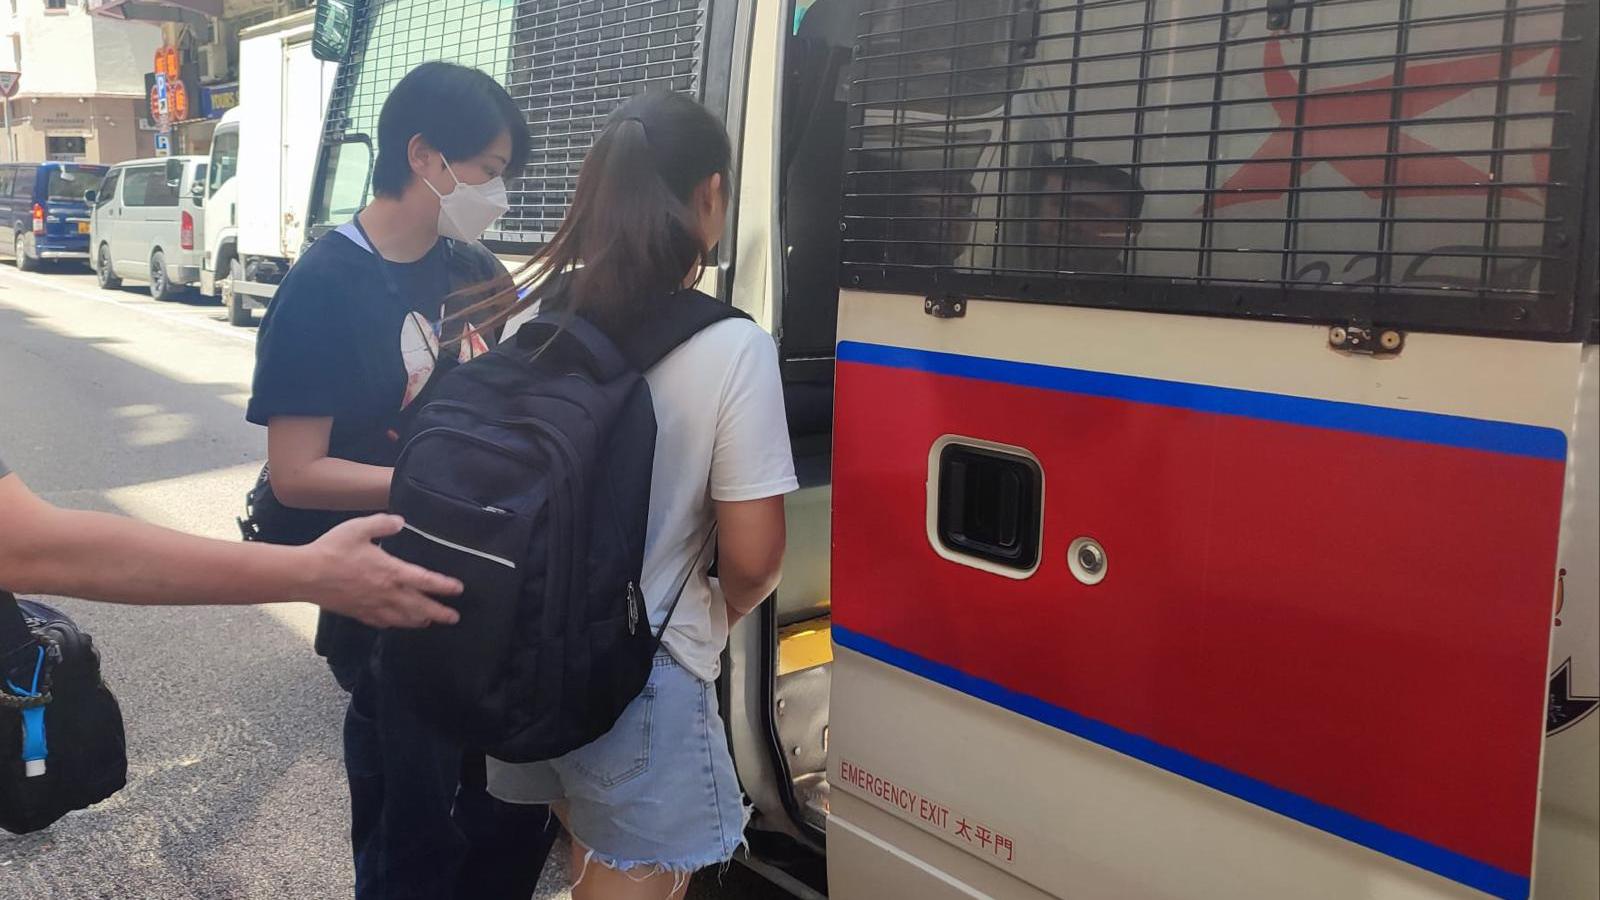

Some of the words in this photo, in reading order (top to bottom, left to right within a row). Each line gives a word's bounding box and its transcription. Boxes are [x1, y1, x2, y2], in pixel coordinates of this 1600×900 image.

[841, 762, 916, 812] EMERGENCY
[920, 799, 949, 829] EXIT
[955, 818, 1013, 861] 太平門
